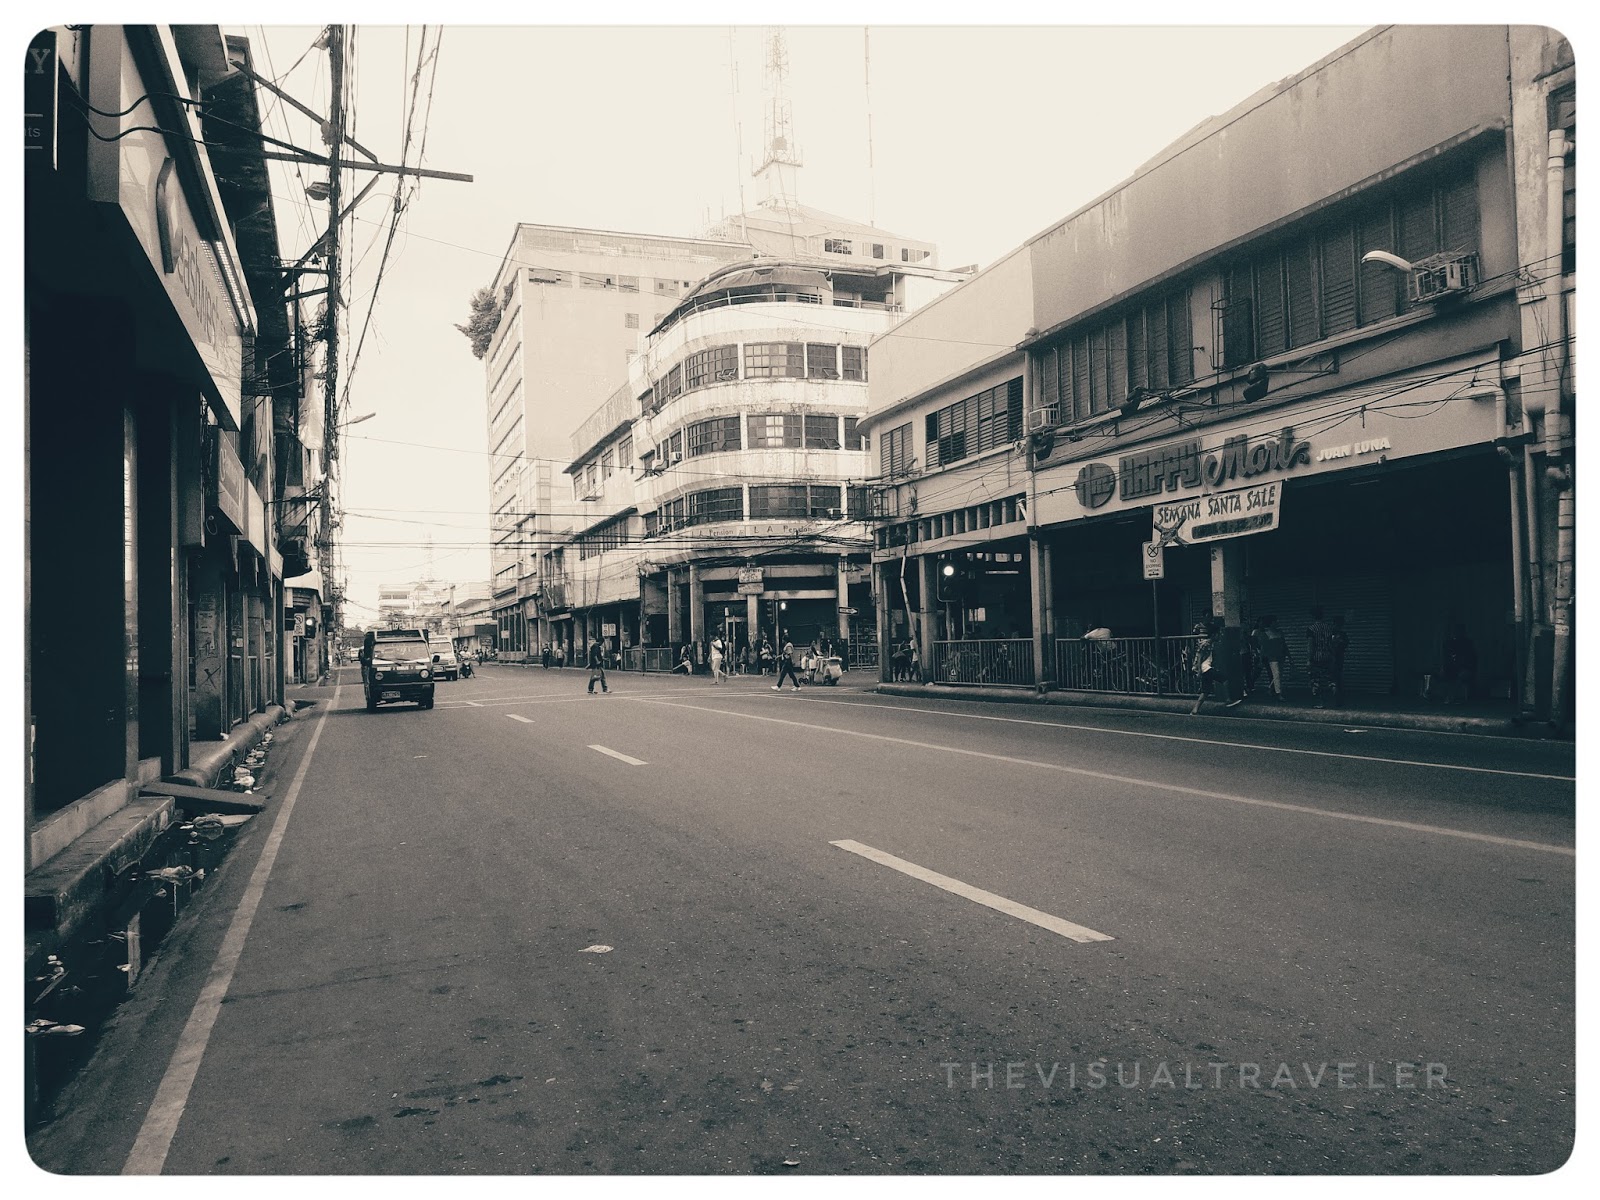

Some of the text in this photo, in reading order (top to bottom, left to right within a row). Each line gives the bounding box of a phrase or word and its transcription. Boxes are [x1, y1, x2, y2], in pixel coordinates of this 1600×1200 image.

[1119, 438, 1202, 501] HAPPY
[1315, 436, 1391, 463] JUAN LUNA
[1157, 484, 1276, 526] SEMANA SANTA SALE
